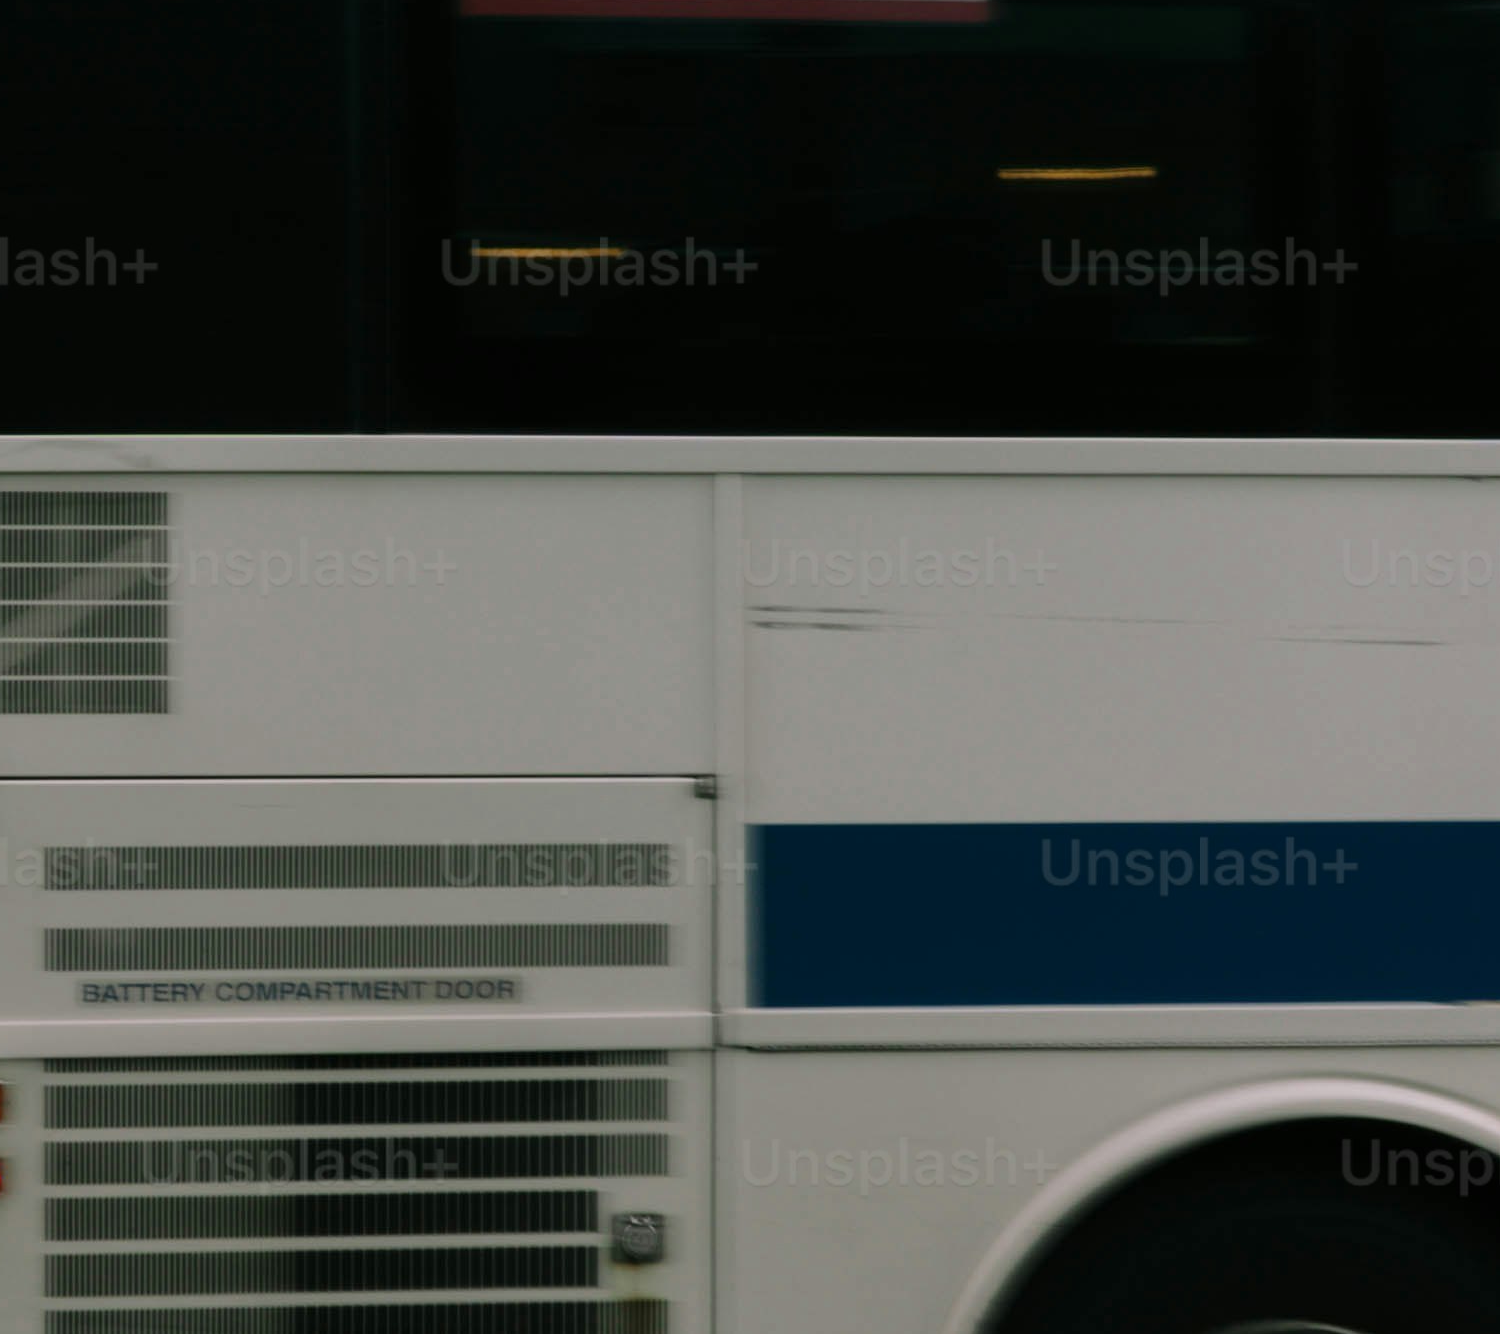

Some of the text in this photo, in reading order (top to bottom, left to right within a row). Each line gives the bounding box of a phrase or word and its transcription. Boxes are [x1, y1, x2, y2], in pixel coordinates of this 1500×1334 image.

[82, 979, 515, 1003] BATTERY COMPARTMENT DOOR
